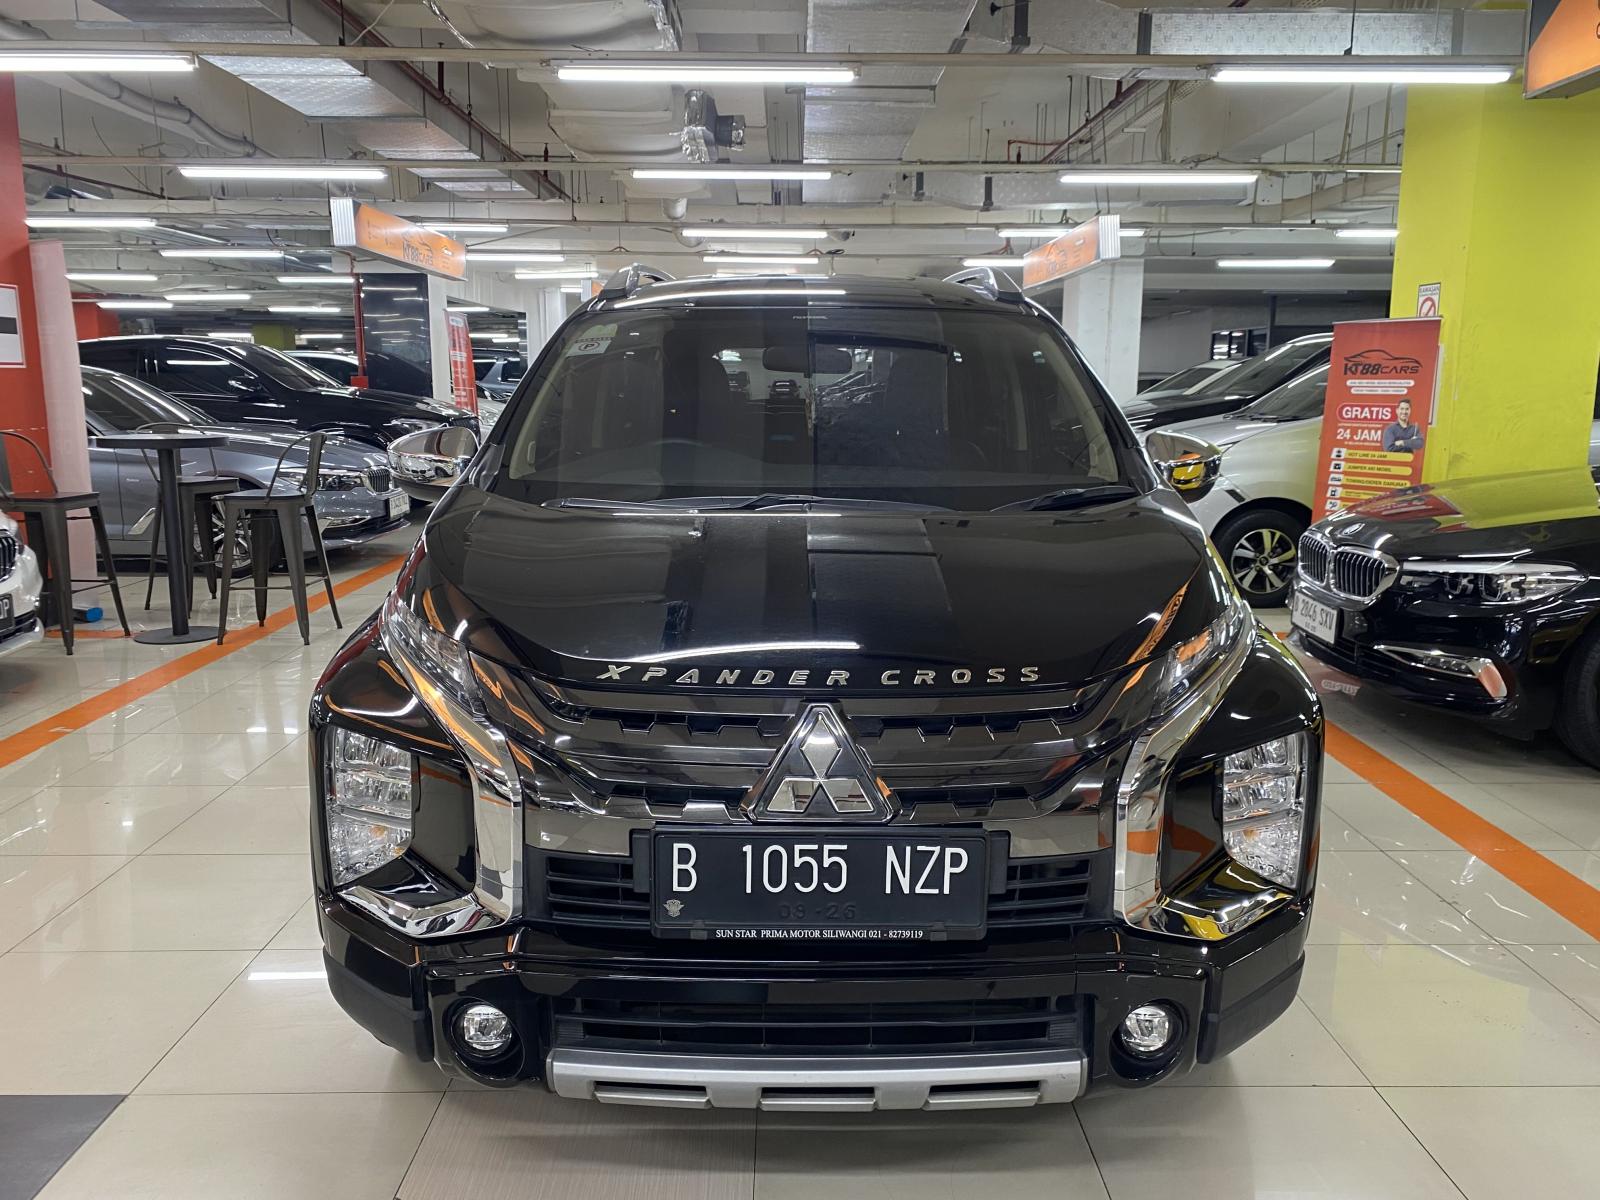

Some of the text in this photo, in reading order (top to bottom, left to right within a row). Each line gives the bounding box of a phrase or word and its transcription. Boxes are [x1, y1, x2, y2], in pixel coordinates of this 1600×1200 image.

[1343, 363, 1420, 375] KT88CARS
[1342, 406, 1392, 420] GRATIS
[1336, 428, 1382, 441] 24 JAM
[596, 664, 1039, 685] XPANDER CROSS
[672, 842, 969, 895] B 1055 NZP
[715, 929, 734, 938] SUN
[735, 929, 757, 938] STAR
[760, 929, 788, 938] PRIMA
[789, 929, 821, 938] MOTOR
[822, 929, 867, 938] SILIWANGI
[868, 929, 882, 938] 021
[888, 929, 923, 938] 82739119
